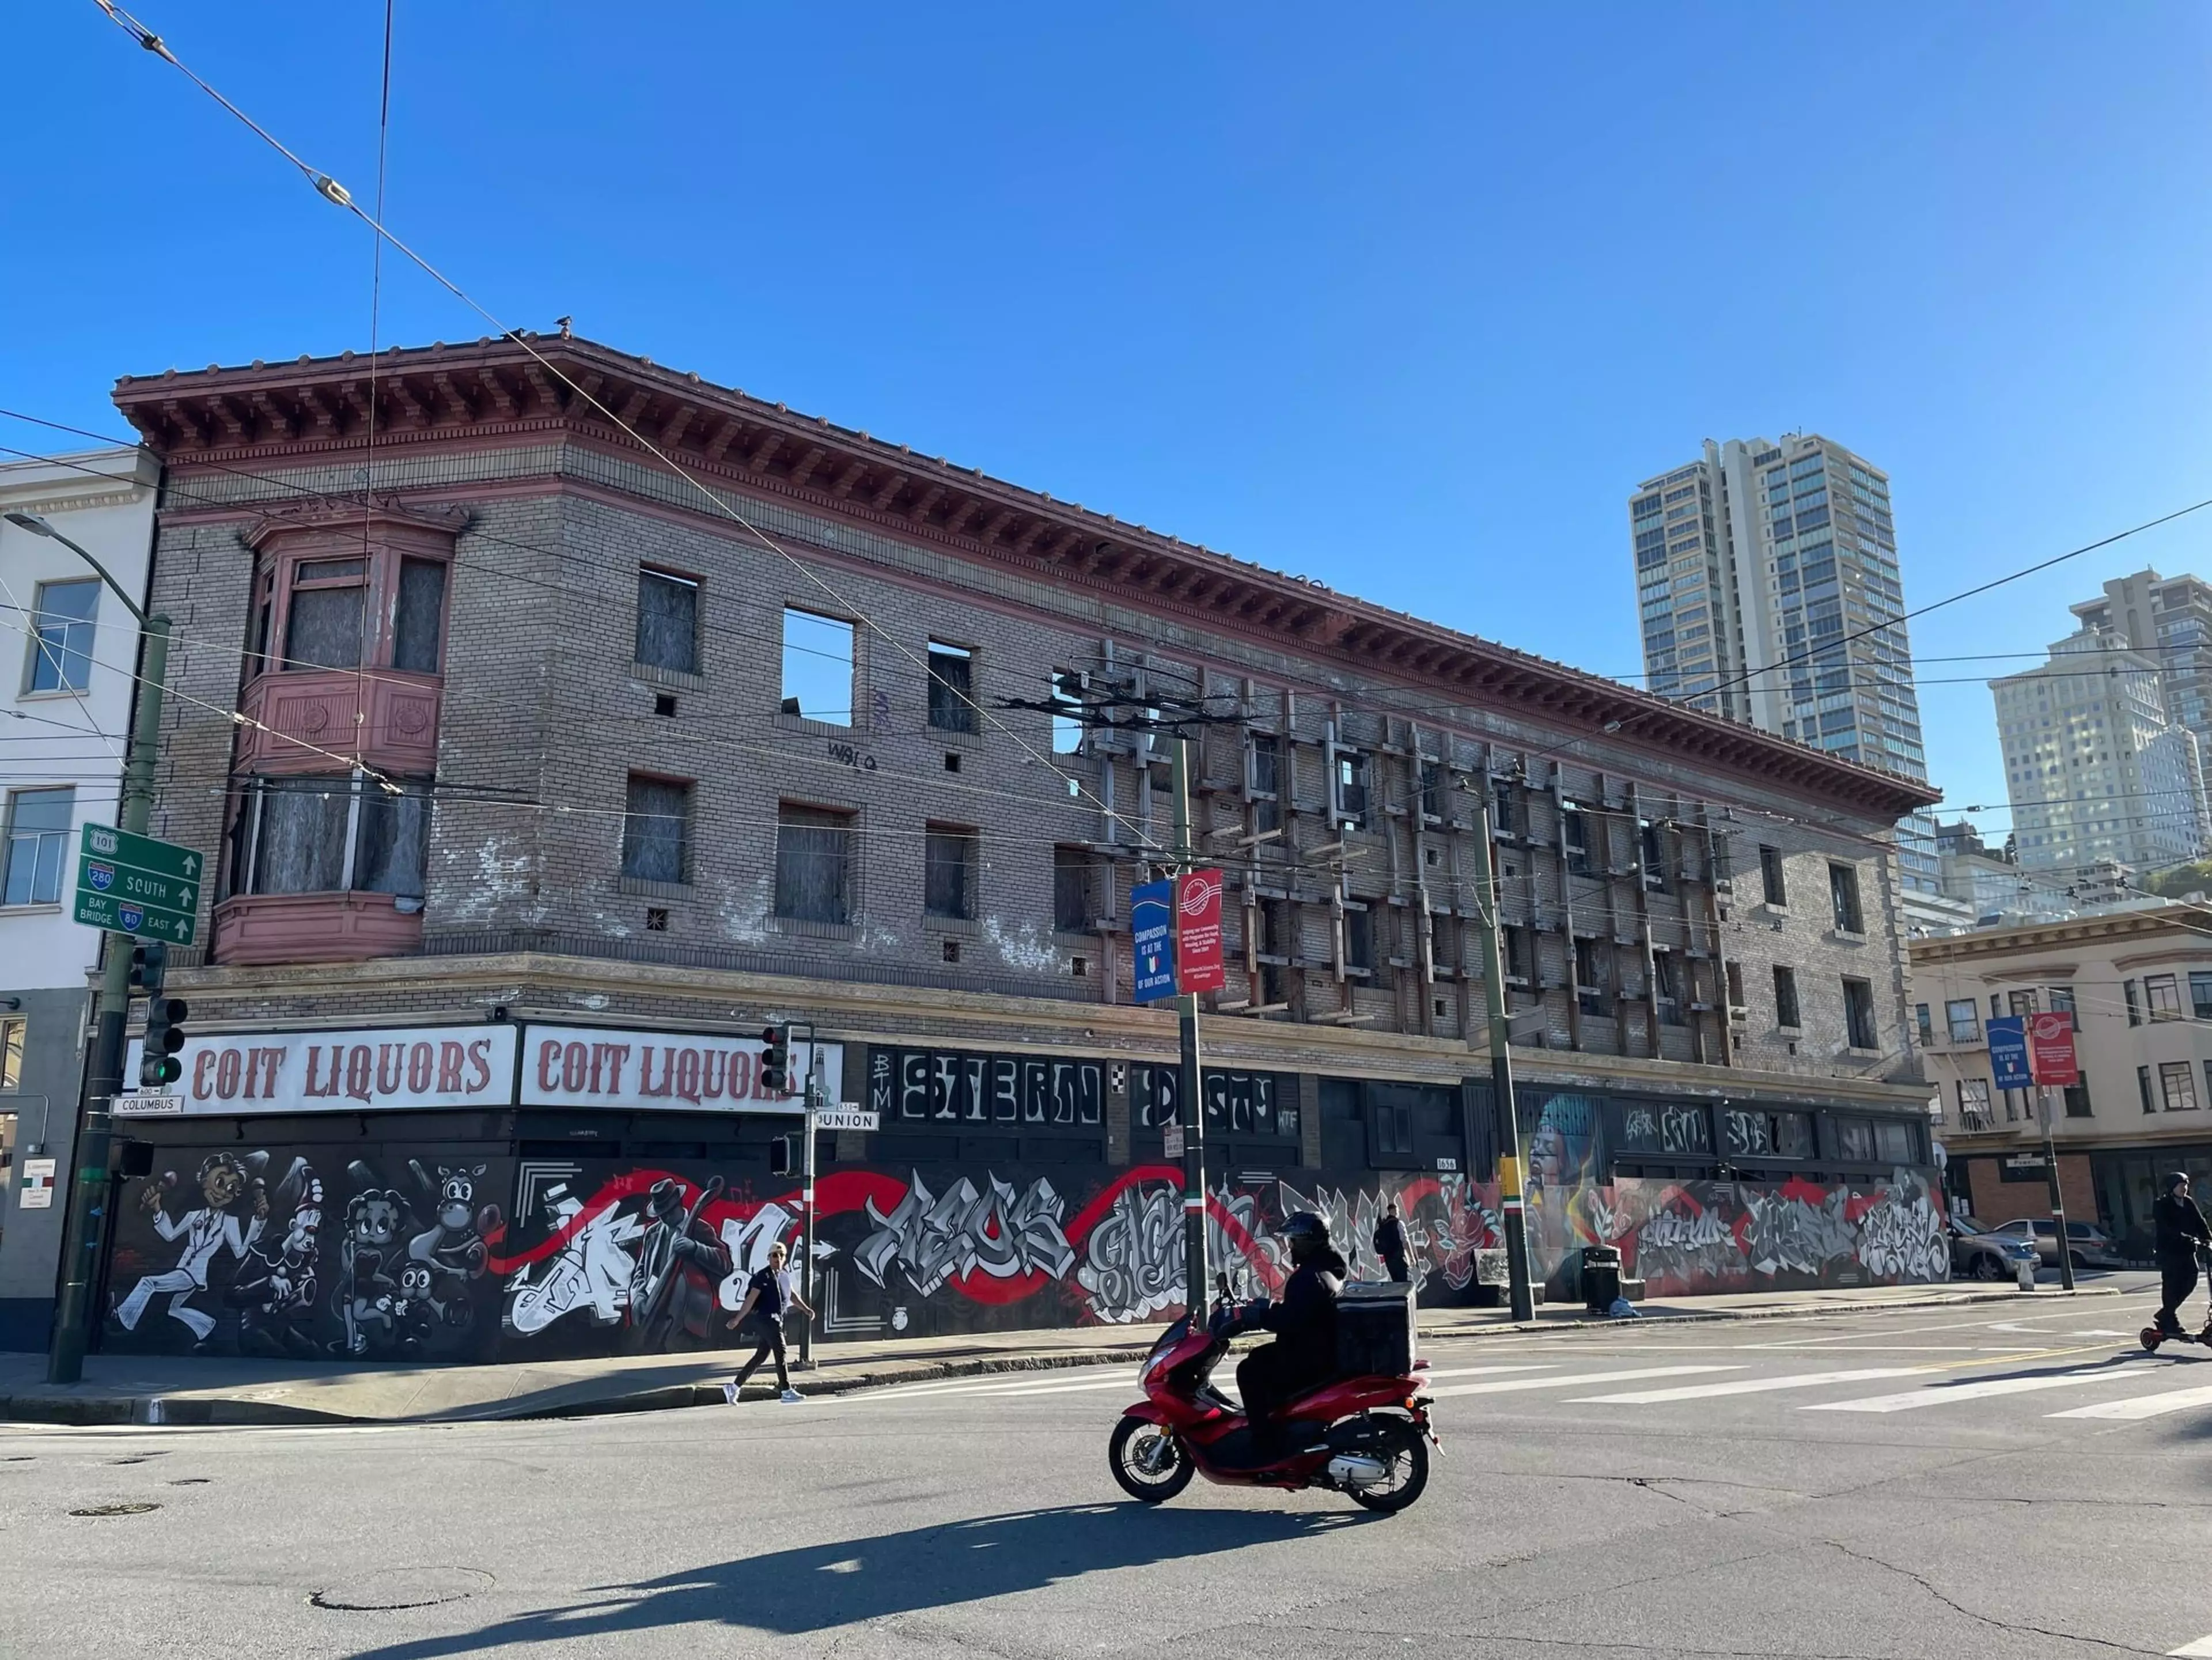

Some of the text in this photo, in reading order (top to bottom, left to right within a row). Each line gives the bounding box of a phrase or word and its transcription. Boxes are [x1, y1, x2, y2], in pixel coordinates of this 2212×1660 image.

[96, 837, 112, 849] 101
[92, 871, 166, 898] 280 SOUTH
[89, 897, 107, 910] BAY
[80, 908, 113, 925] BRIDGE
[124, 913, 170, 930] 80 EAST
[192, 1038, 491, 1105] COIT LIQUORS
[537, 1040, 631, 1095] COIT
[122, 1099, 174, 1110] COLUMBUS
[823, 1114, 872, 1127] UNION
